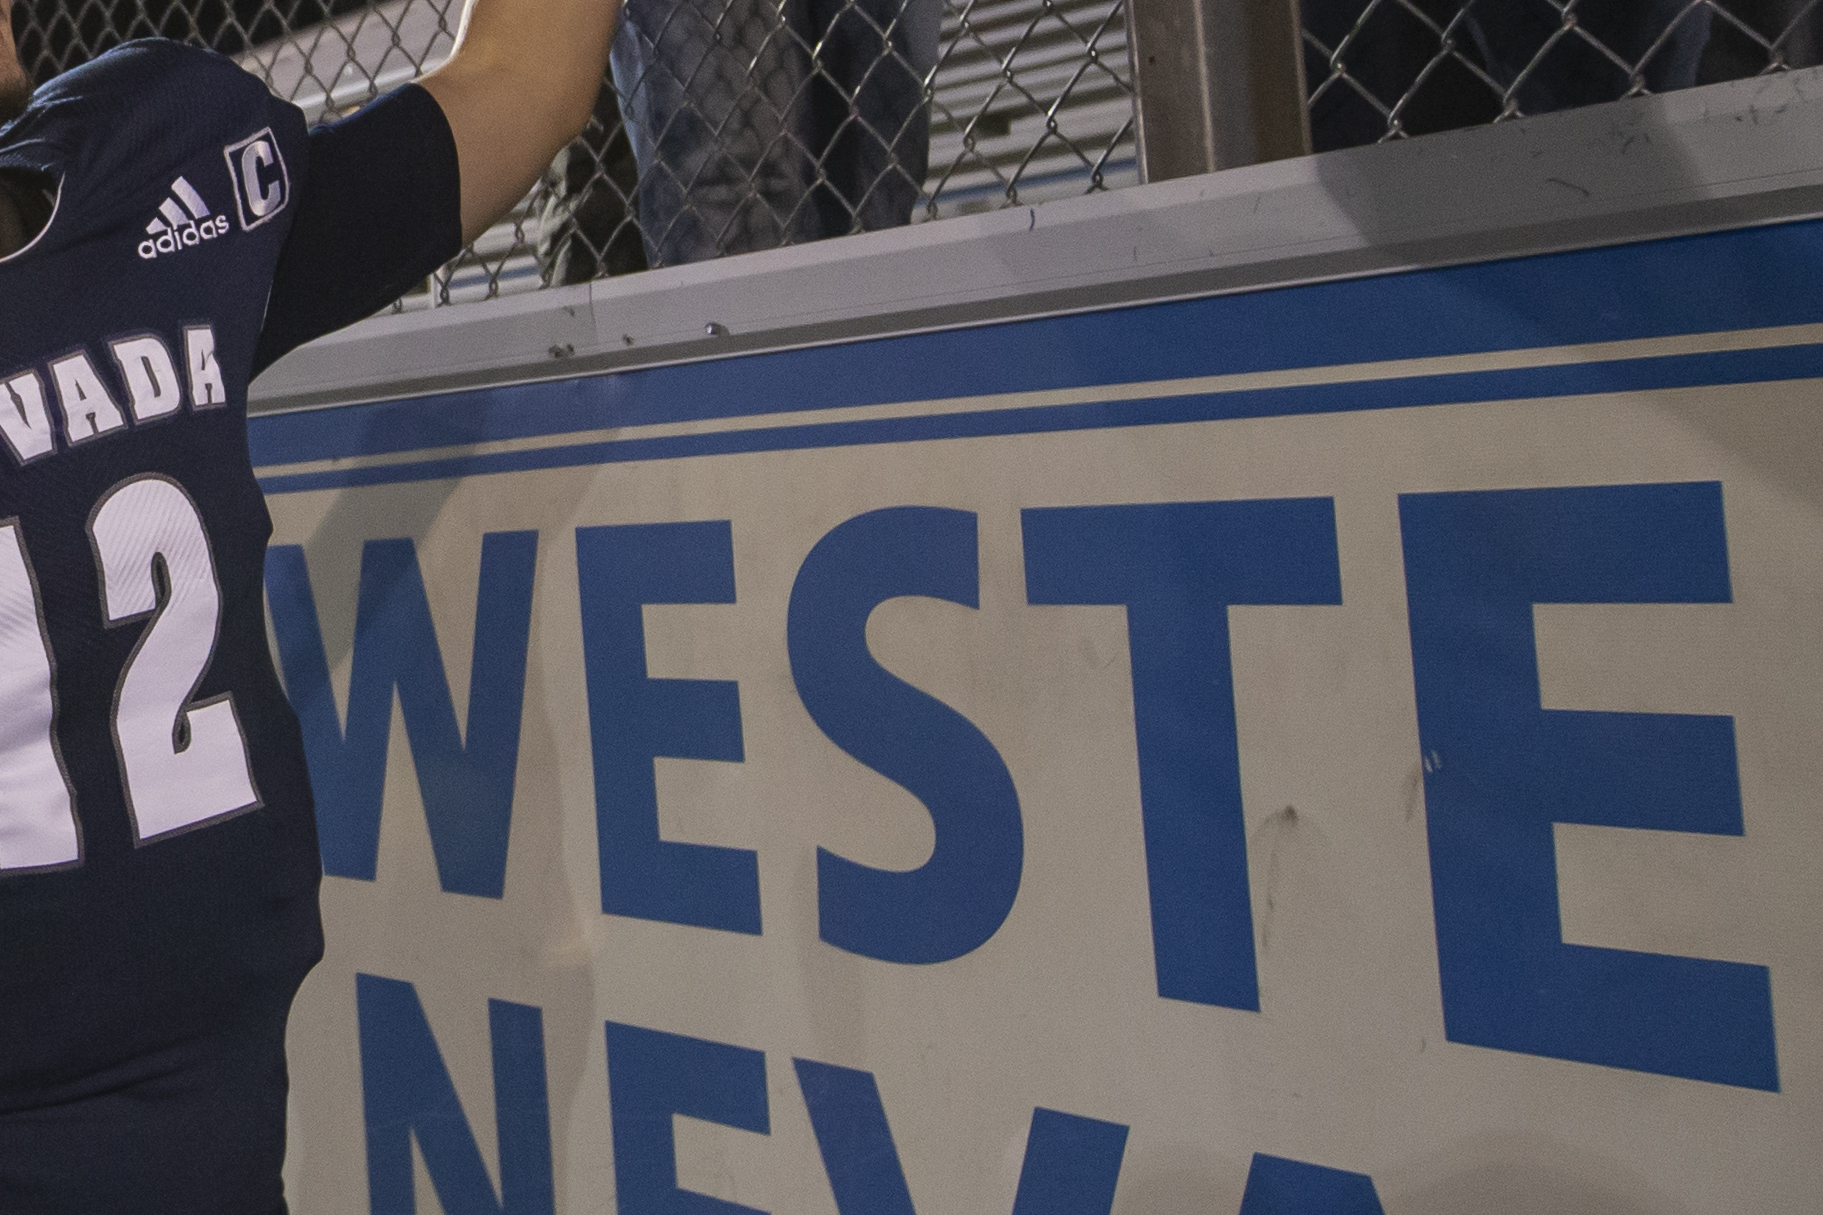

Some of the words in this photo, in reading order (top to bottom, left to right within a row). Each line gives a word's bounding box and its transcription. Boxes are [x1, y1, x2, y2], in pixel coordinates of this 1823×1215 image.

[241, 140, 282, 217] C
[137, 214, 229, 259] adidas
[262, 480, 1781, 1093] WESTE
